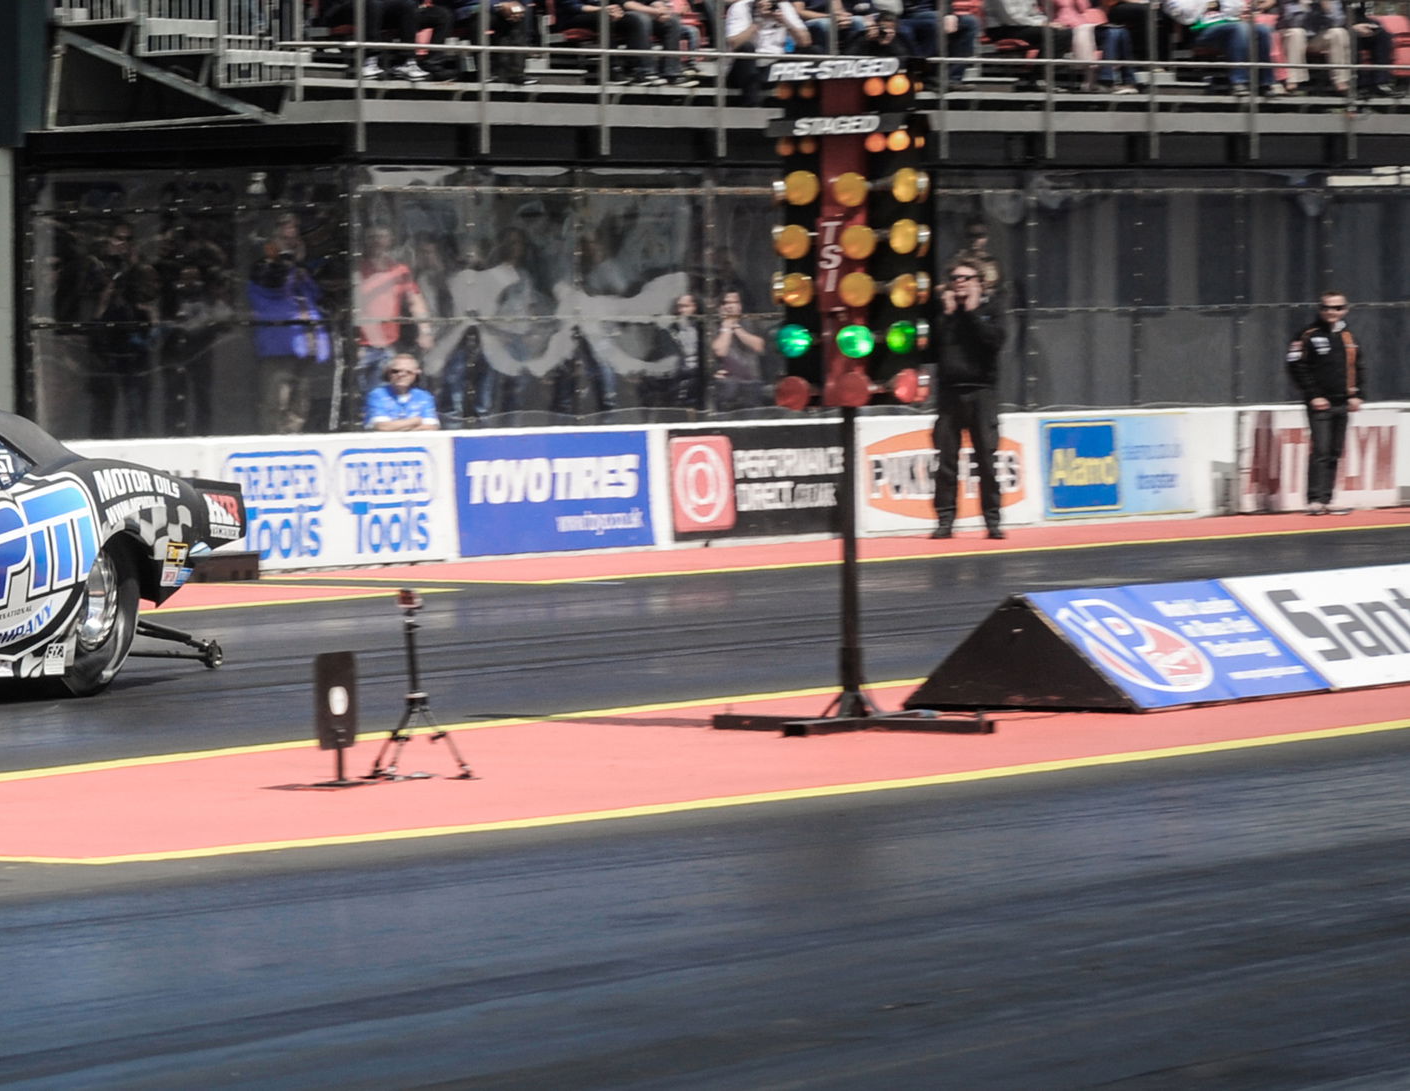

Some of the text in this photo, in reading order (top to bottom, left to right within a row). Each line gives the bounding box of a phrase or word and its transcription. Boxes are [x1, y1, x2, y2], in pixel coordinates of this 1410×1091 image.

[768, 57, 900, 81] PRE-STAGED
[793, 115, 880, 137] STAGED
[92, 468, 180, 503] MOTOR OILS
[467, 454, 640, 504] TOYO TIRES
